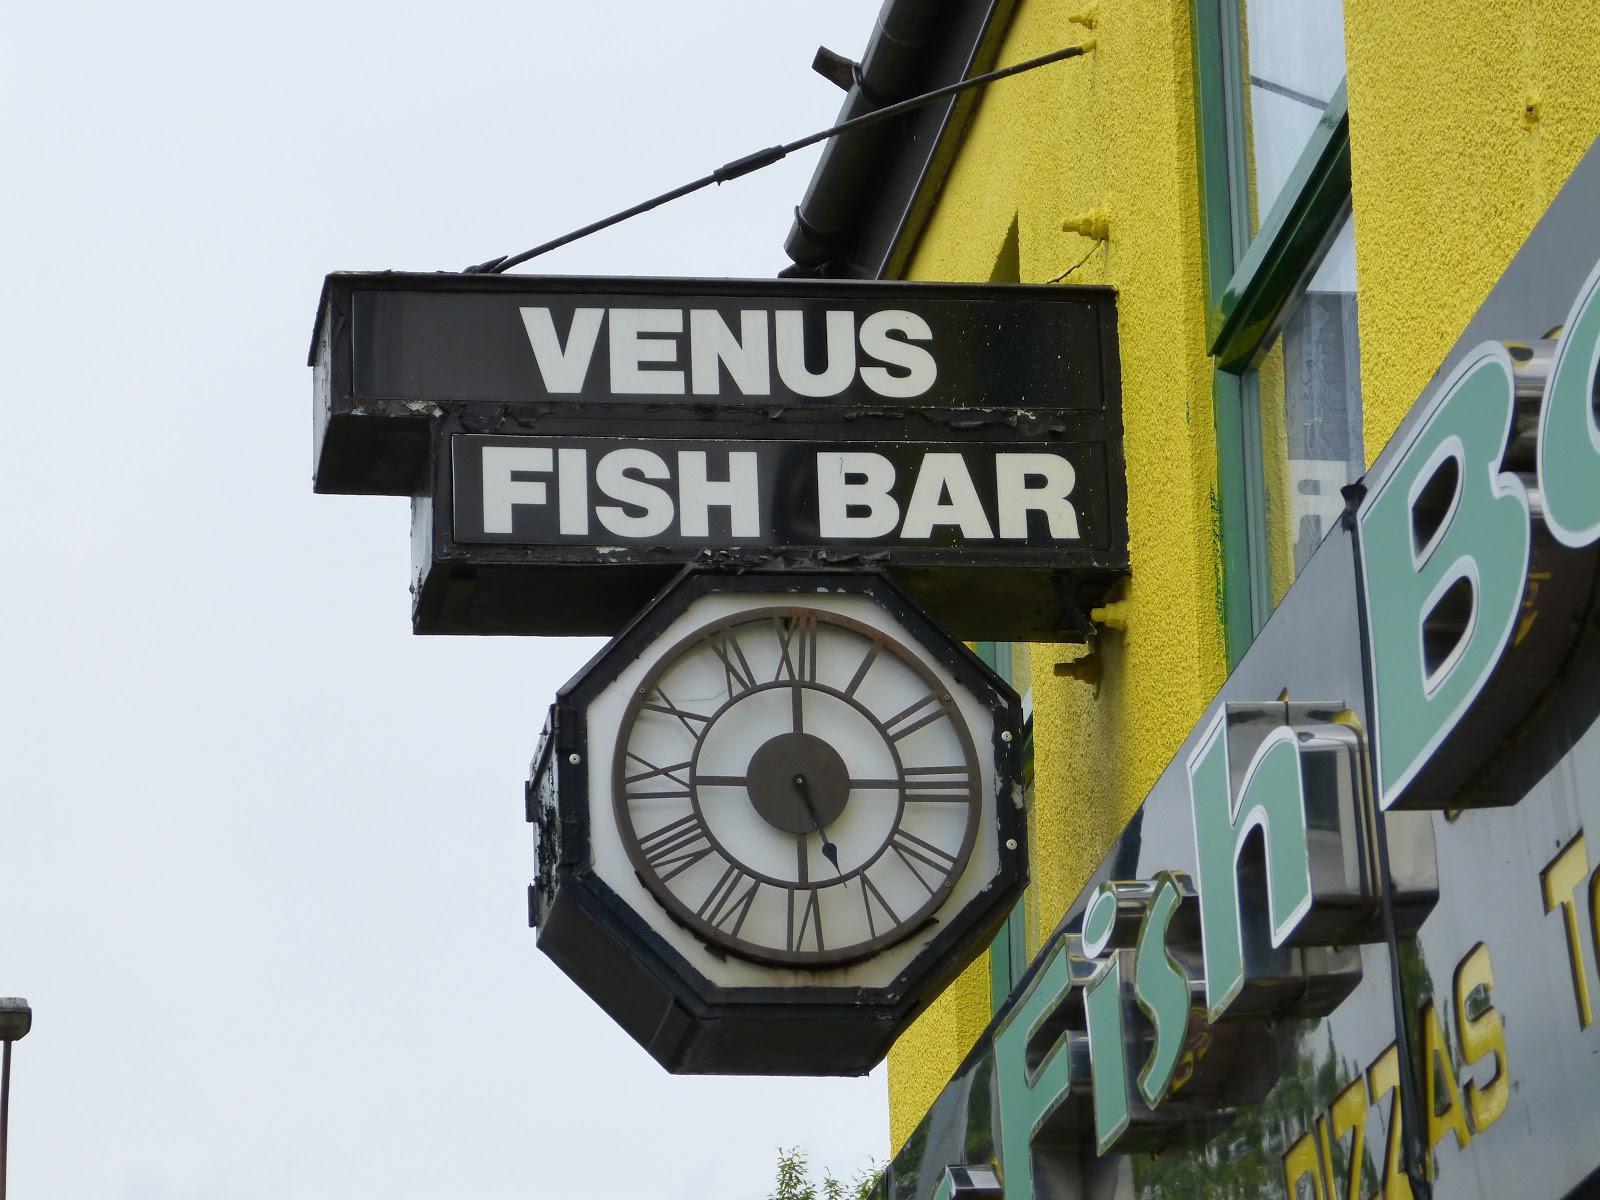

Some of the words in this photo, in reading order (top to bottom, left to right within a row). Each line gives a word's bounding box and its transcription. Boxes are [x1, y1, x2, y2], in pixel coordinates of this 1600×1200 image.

[519, 306, 939, 398] VENUS
[480, 446, 760, 538] FISH
[816, 452, 1079, 540] BAR
[994, 702, 1314, 1200] Fish
[1539, 826, 1600, 1032] T
